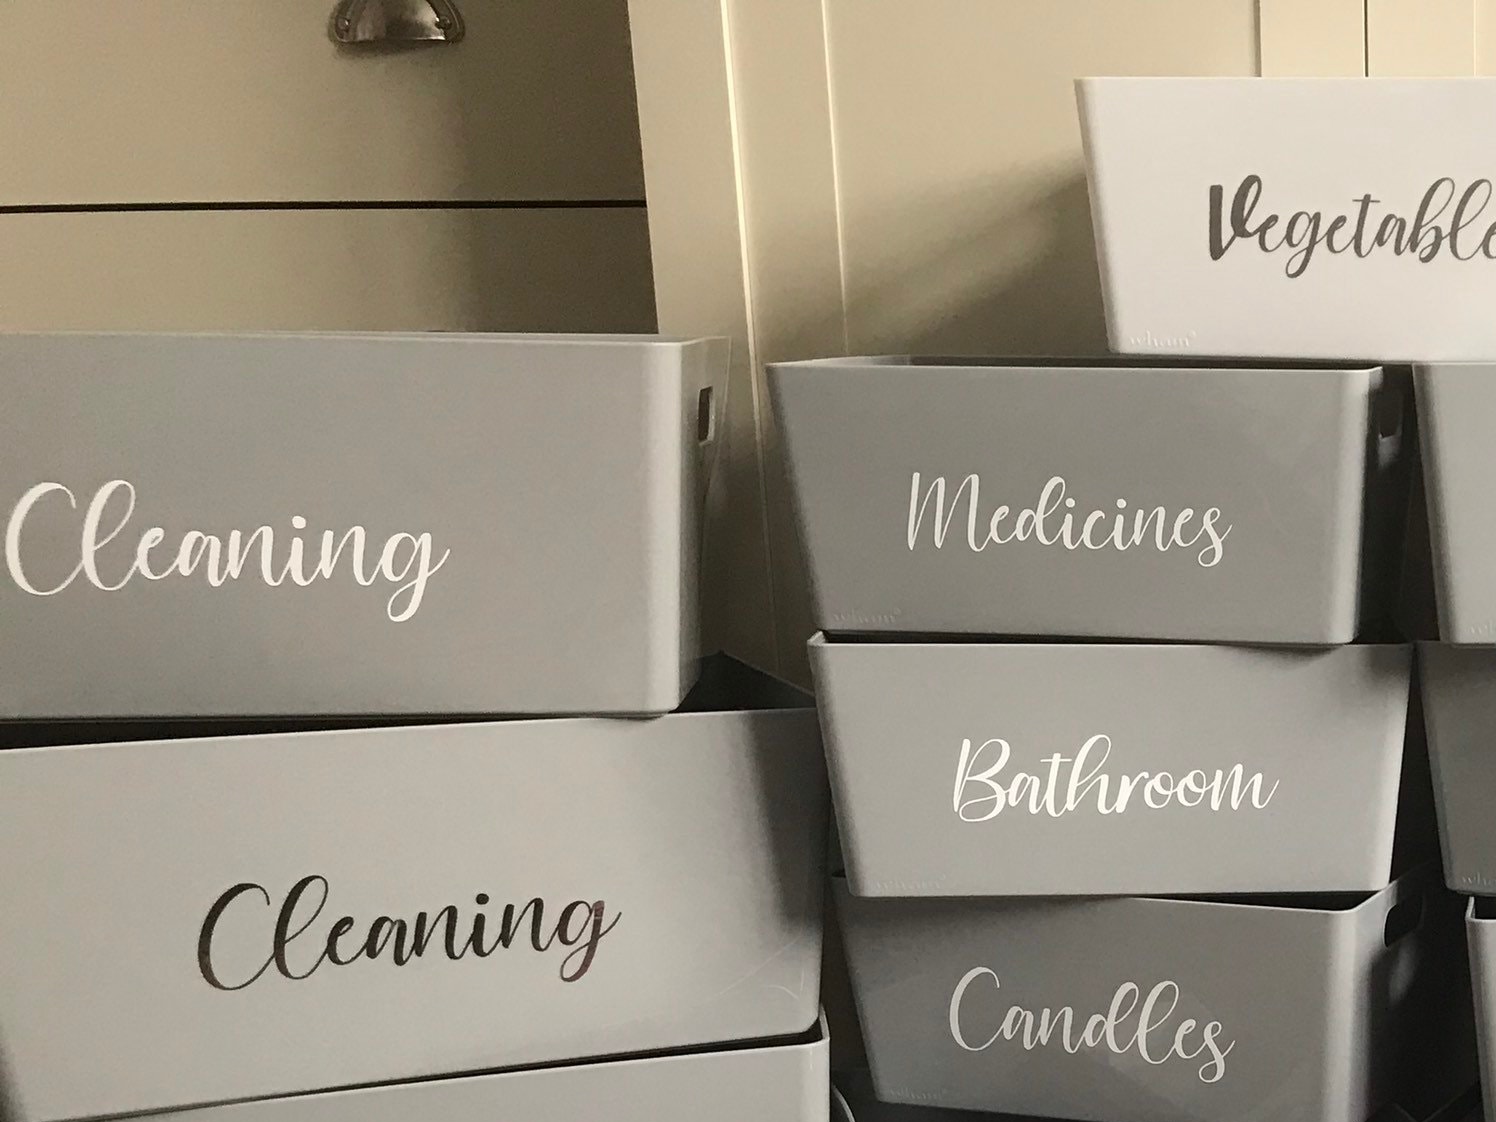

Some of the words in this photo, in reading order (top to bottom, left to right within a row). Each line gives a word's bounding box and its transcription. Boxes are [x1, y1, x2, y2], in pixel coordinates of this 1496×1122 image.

[5, 480, 450, 622] Cleaning
[908, 472, 1232, 567] Medicines
[953, 734, 1279, 822] Bathroom
[197, 875, 622, 990] Cleaning
[949, 967, 1235, 1083] Candles
